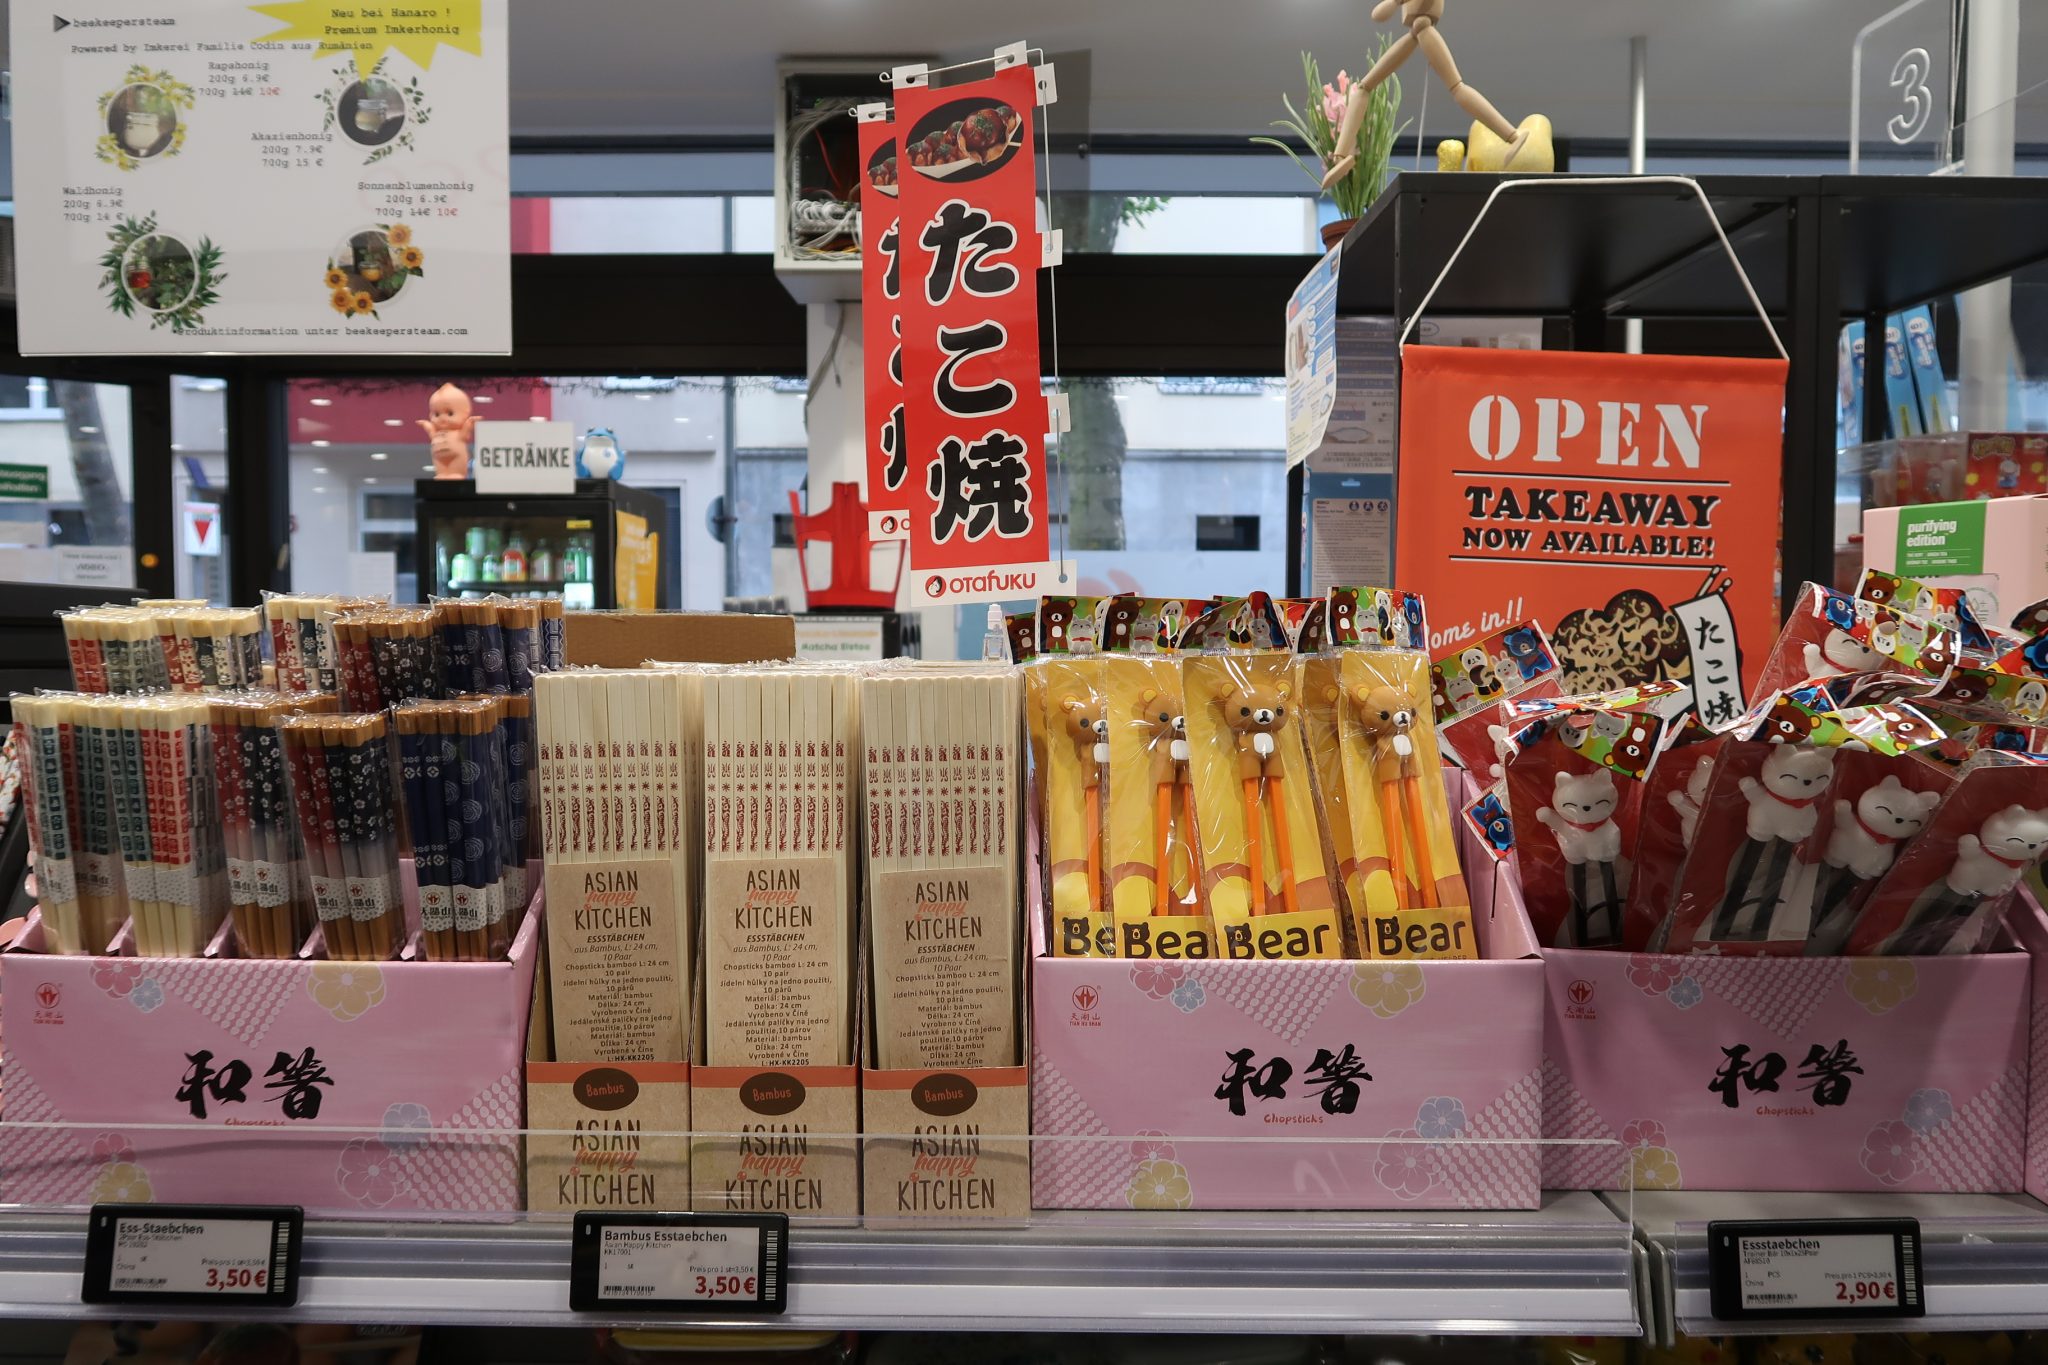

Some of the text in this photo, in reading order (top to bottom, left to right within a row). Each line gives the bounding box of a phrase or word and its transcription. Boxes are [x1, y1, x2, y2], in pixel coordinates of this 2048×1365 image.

[331, 8, 354, 18] Neu
[361, 8, 384, 17] bei
[391, 8, 437, 17] Hanaro
[73, 17, 176, 29] beekeepersteam
[324, 25, 460, 36] Premium Imkerhonig
[71, 45, 118, 53] Powered
[123, 44, 137, 54] by
[143, 43, 190, 52] Imkerei
[197, 43, 244, 51] Familie
[250, 42, 285, 50] Codin
[208, 75, 236, 84] 200g
[199, 88, 225, 97] 700g
[258, 87, 281, 96] 10€
[1887, 47, 1932, 145] 3
[251, 132, 333, 142] Akazienhonig
[261, 146, 288, 155] 200g
[262, 159, 289, 168] 700g
[295, 158, 309, 167] 15
[62, 187, 122, 197] Waldhonig
[357, 181, 474, 192] Sonnenblumenhonig
[63, 200, 90, 210] 200g
[385, 195, 447, 204] 200g 6.9€
[63, 213, 90, 223] 700g
[375, 208, 403, 218] 700g
[437, 207, 459, 216] 10€
[305, 327, 339, 336] unter
[345, 326, 468, 338] beekeepersteam.com
[919, 198, 1034, 546] たこ焼
[1468, 394, 1709, 469] OPEN
[480, 443, 571, 469] GETRÄNKE
[1464, 485, 1722, 529] TAKEAWAY
[1907, 519, 1957, 535] purifying
[1462, 526, 1716, 559] NOW AVAILABLE!
[1906, 534, 1946, 547] edition
[1481, 596, 1524, 634] in!!
[1694, 615, 1745, 727] たこ焼
[584, 870, 639, 893] ASIAN
[746, 868, 800, 892] ASIAN
[585, 889, 636, 907] happy
[747, 887, 799, 906] happy
[915, 880, 969, 904] ASIAN
[917, 900, 967, 917] happy
[574, 906, 652, 931] KITCHEN
[735, 905, 813, 930] KITCHEN
[905, 916, 982, 942] KITCHEN
[1062, 916, 1116, 957] Be
[1374, 916, 1466, 956] Bear
[587, 933, 645, 944] ESSSTÄBCHEN
[746, 933, 805, 943] ESSSTÄBCHEN
[1122, 922, 1208, 958] Bea
[1224, 922, 1330, 958] Bear
[792, 943, 803, 951] 24
[917, 943, 975, 954] ESSSTÄBCHEN
[773, 953, 791, 961] Paar
[723, 963, 763, 971] Chopsticks
[774, 970, 789, 978] pair
[780, 978, 802, 986] jedno
[747, 1011, 784, 1020] Vyrobeno
[807, 1017, 829, 1026] jedno
[585, 1082, 625, 1097] Bambus
[752, 1088, 792, 1102] Bambus
[924, 1088, 964, 1103] Bambus
[1756, 1105, 1815, 1116] Chopsticks
[1263, 1113, 1324, 1125] Chopsticks
[572, 1119, 641, 1152] ASIAN
[739, 1124, 808, 1156] ASIAN
[912, 1124, 980, 1157] ASIAN
[574, 1146, 638, 1174] happy
[741, 1152, 805, 1178] happy
[914, 1152, 977, 1178] happy
[559, 1174, 655, 1205] KITCHEN
[725, 1179, 823, 1210] KITCHEN
[898, 1178, 996, 1211] KITCHEN
[119, 1223, 204, 1235] Ess-Staebchen
[604, 1230, 728, 1242] Bambus Esstaebchen
